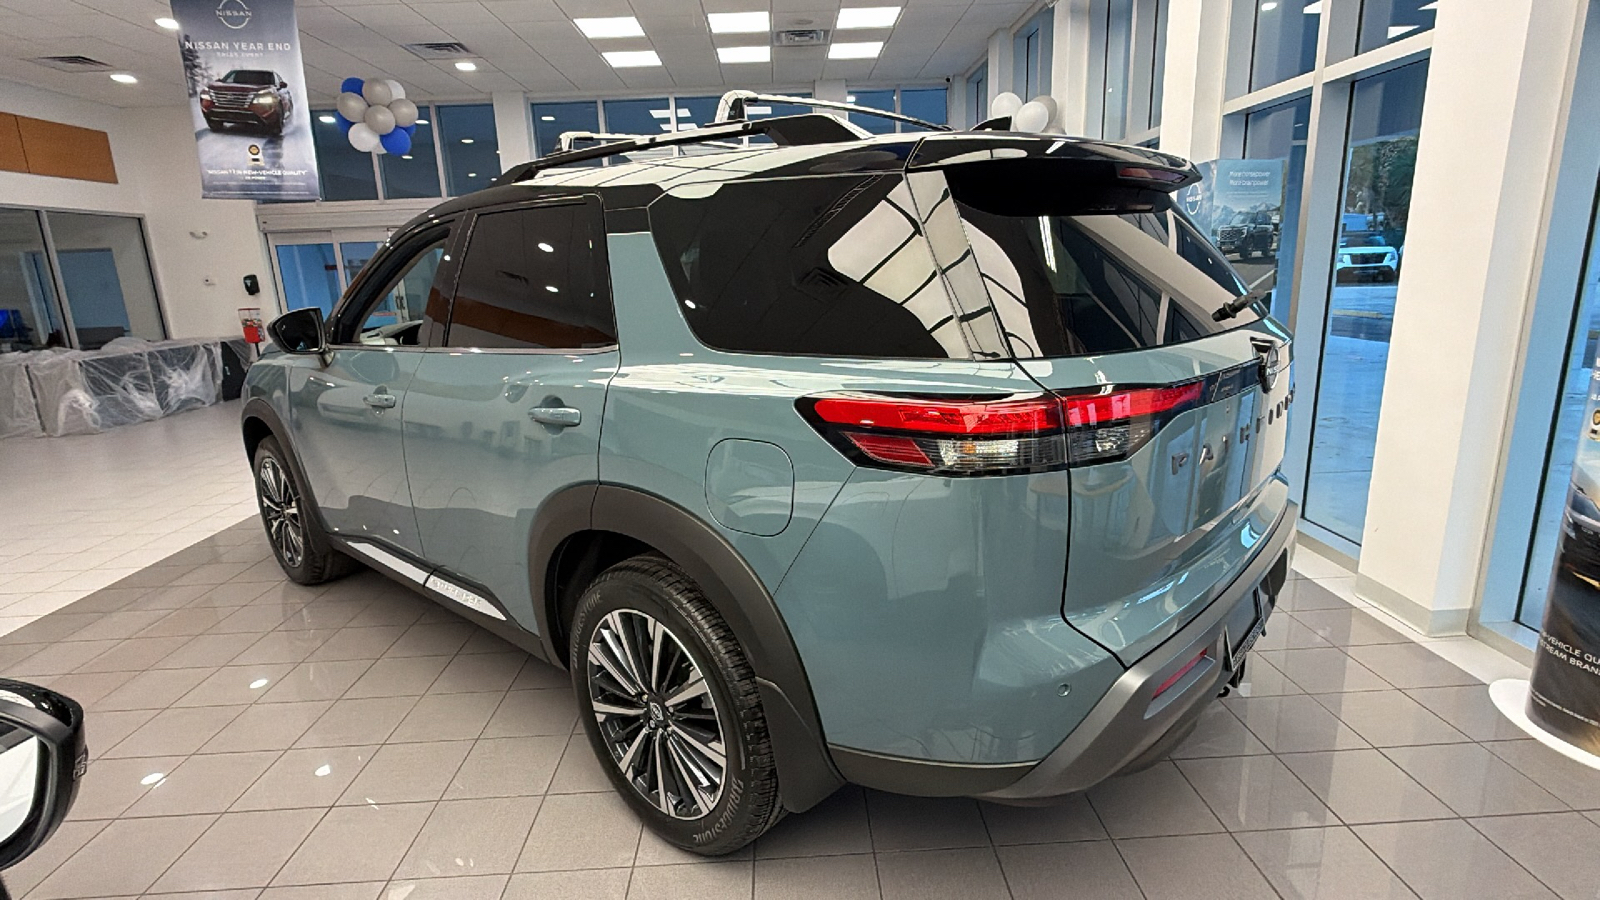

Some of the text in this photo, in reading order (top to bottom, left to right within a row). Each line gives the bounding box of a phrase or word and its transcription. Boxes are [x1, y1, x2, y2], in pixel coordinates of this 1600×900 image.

[184, 41, 291, 51] NISSAN YEAR END
